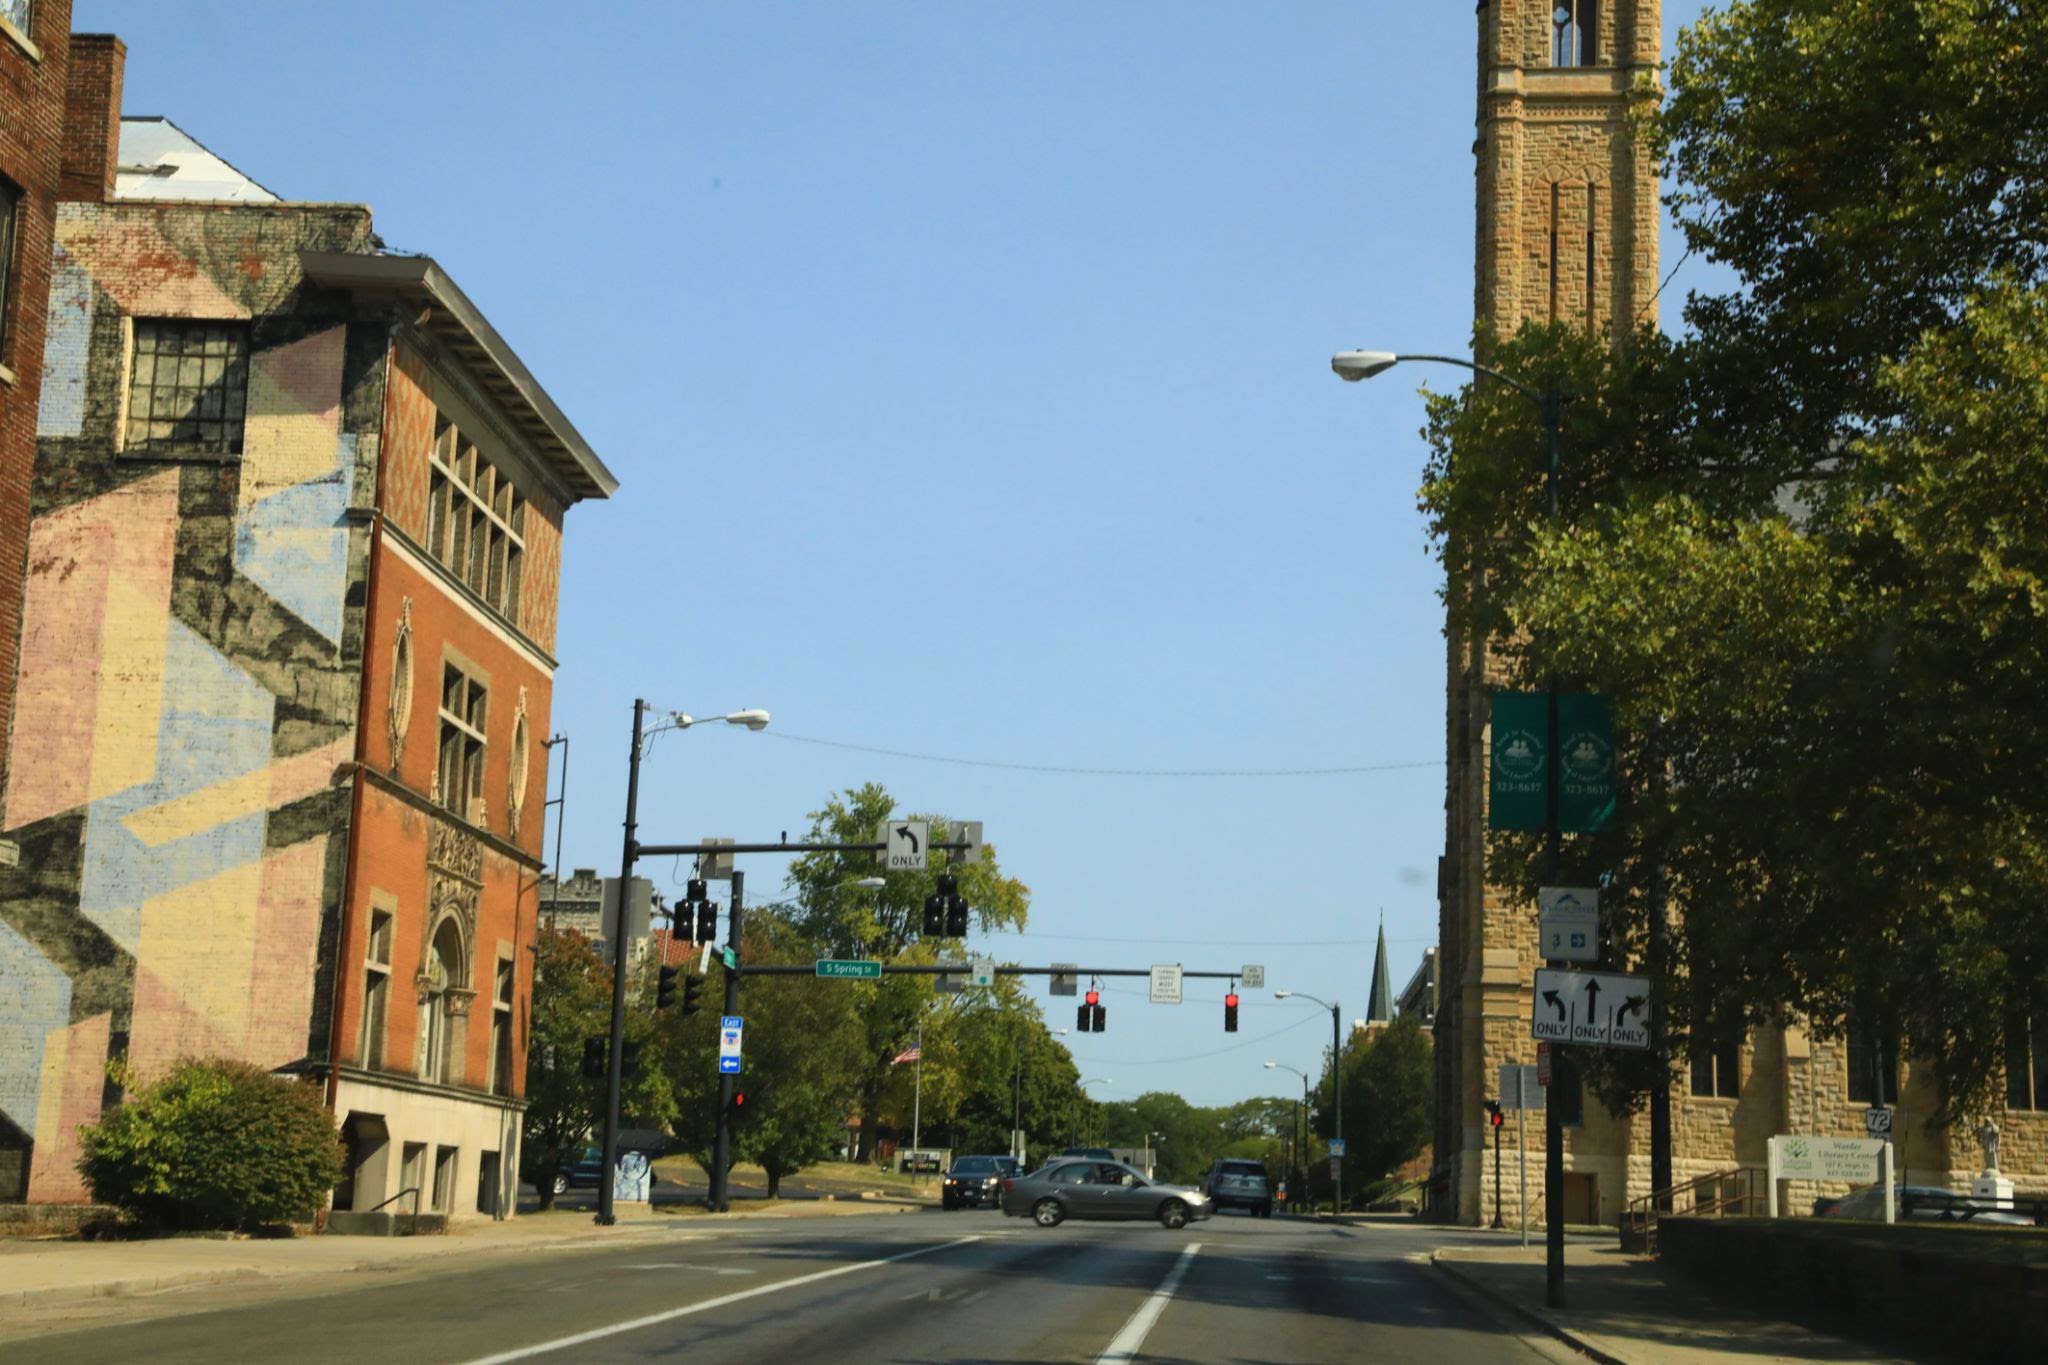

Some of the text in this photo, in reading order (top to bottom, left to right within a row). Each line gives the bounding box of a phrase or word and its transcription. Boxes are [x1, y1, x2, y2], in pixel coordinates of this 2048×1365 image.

[1496, 781, 1543, 793] 323-8617
[891, 855, 922, 866] ONLY
[1552, 933, 1561, 949] 3
[826, 963, 833, 973] S
[834, 963, 863, 976] Spring
[1536, 1022, 1646, 1042] ONLY ONLY ONLY
[1868, 1112, 1889, 1127] 72
